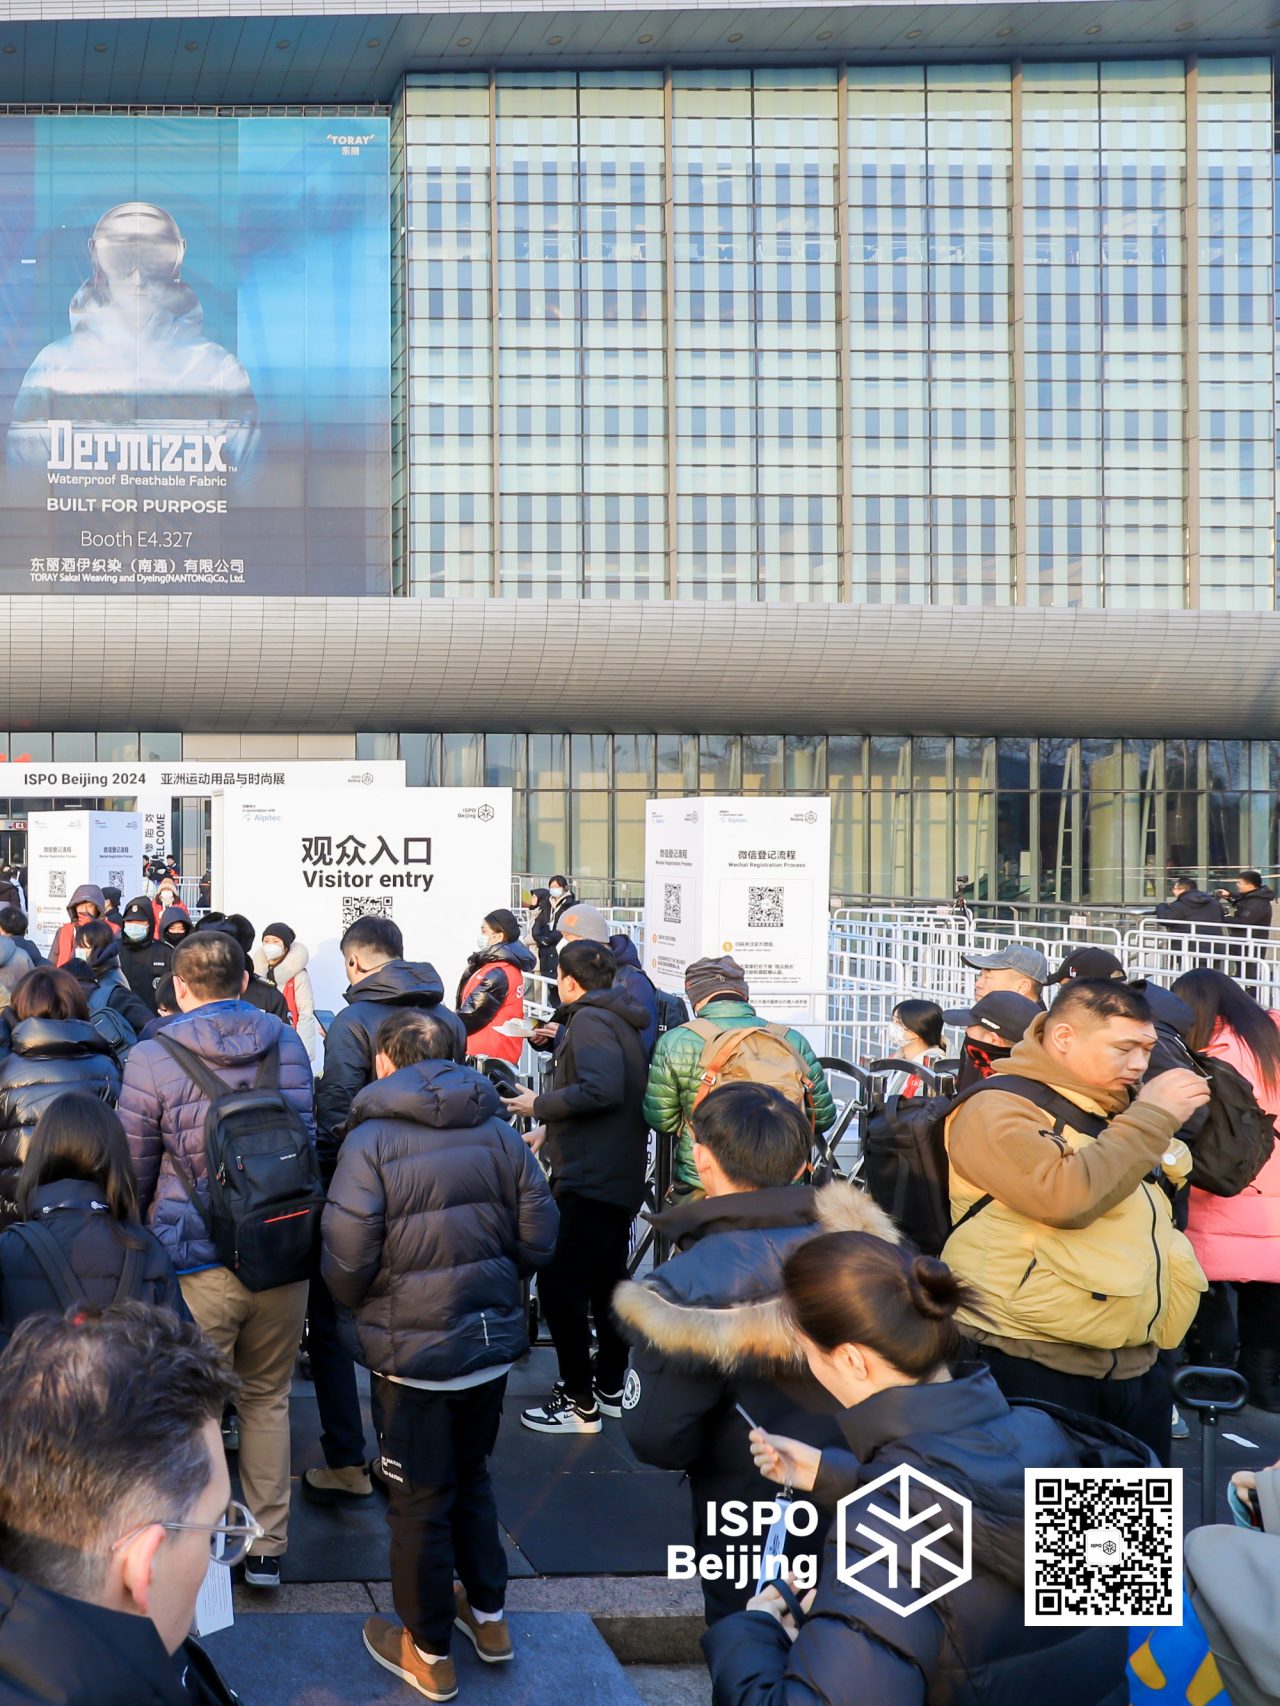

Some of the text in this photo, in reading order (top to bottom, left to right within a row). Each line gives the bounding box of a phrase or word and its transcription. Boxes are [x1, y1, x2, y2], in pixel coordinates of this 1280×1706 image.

[47, 419, 227, 473] Dermizax
[47, 472, 227, 487] Waterproof Breathable Fabric
[47, 497, 228, 514] BUILT FOR PURPOSE
[81, 530, 193, 548] Booth E4.327
[30, 557, 245, 573] 东丽酒伊织染（南通）有限公司
[30, 573, 57, 582] TORAY
[59, 573, 80, 582] Sakai
[83, 573, 117, 584] Weaving
[119, 573, 135, 582] and
[230, 574, 245, 583] Ltd.
[24, 772, 285, 787] ISPO Beijing 2024 亚洲运动用品与时尚展
[156, 813, 166, 858] ELCOME
[301, 835, 432, 866] 观众入口
[738, 850, 796, 860] 微信登记流程
[302, 870, 434, 892] Visitor entry
